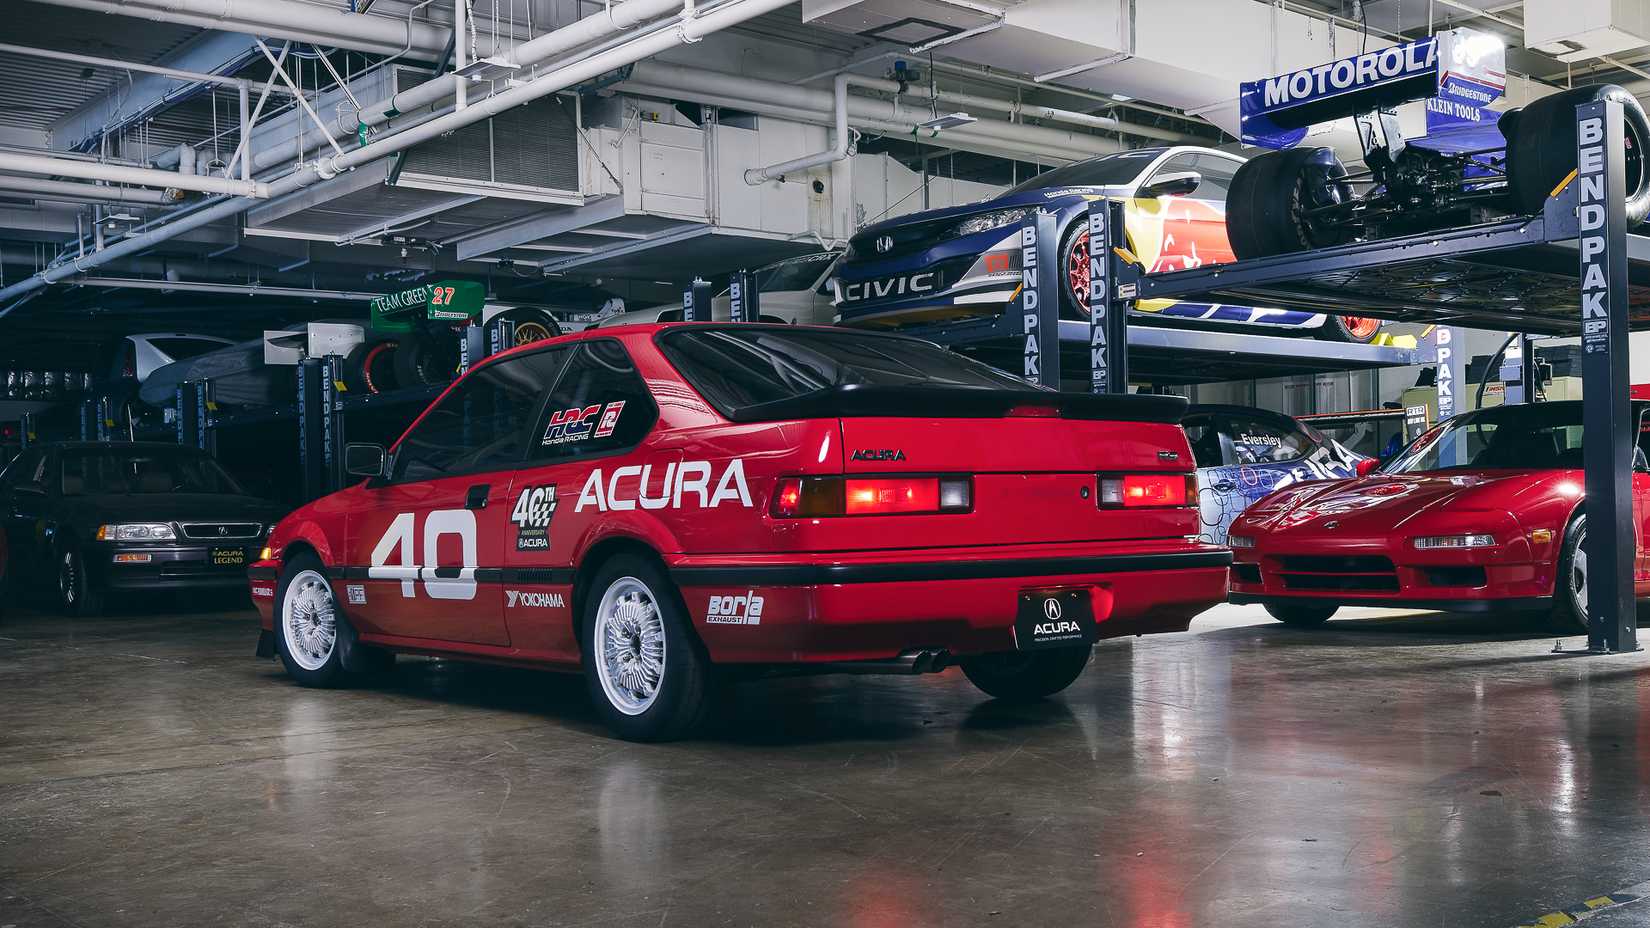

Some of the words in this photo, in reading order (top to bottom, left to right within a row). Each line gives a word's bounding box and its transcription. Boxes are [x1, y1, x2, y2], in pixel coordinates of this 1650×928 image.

[1427, 98, 1453, 116] KLEIN
[1455, 103, 1480, 122] TOOLS
[1580, 117, 1607, 319] BENDPAK
[432, 286, 455, 305] 27
[846, 272, 935, 301] CIVIC
[1090, 213, 1107, 368] BENDPAK
[375, 293, 402, 312] TEAM
[1022, 227, 1039, 375] BENDPAK
[322, 366, 331, 453] BENDPAK
[565, 433, 589, 443] RACING
[1241, 433, 1281, 448] Eversley
[850, 449, 906, 461] ACURA
[574, 458, 754, 513] ACURA
[523, 539, 548, 548] ACURA
[369, 509, 479, 600] 40
[519, 593, 565, 608] YOKOHAMA
[1033, 621, 1081, 635] ACURA
